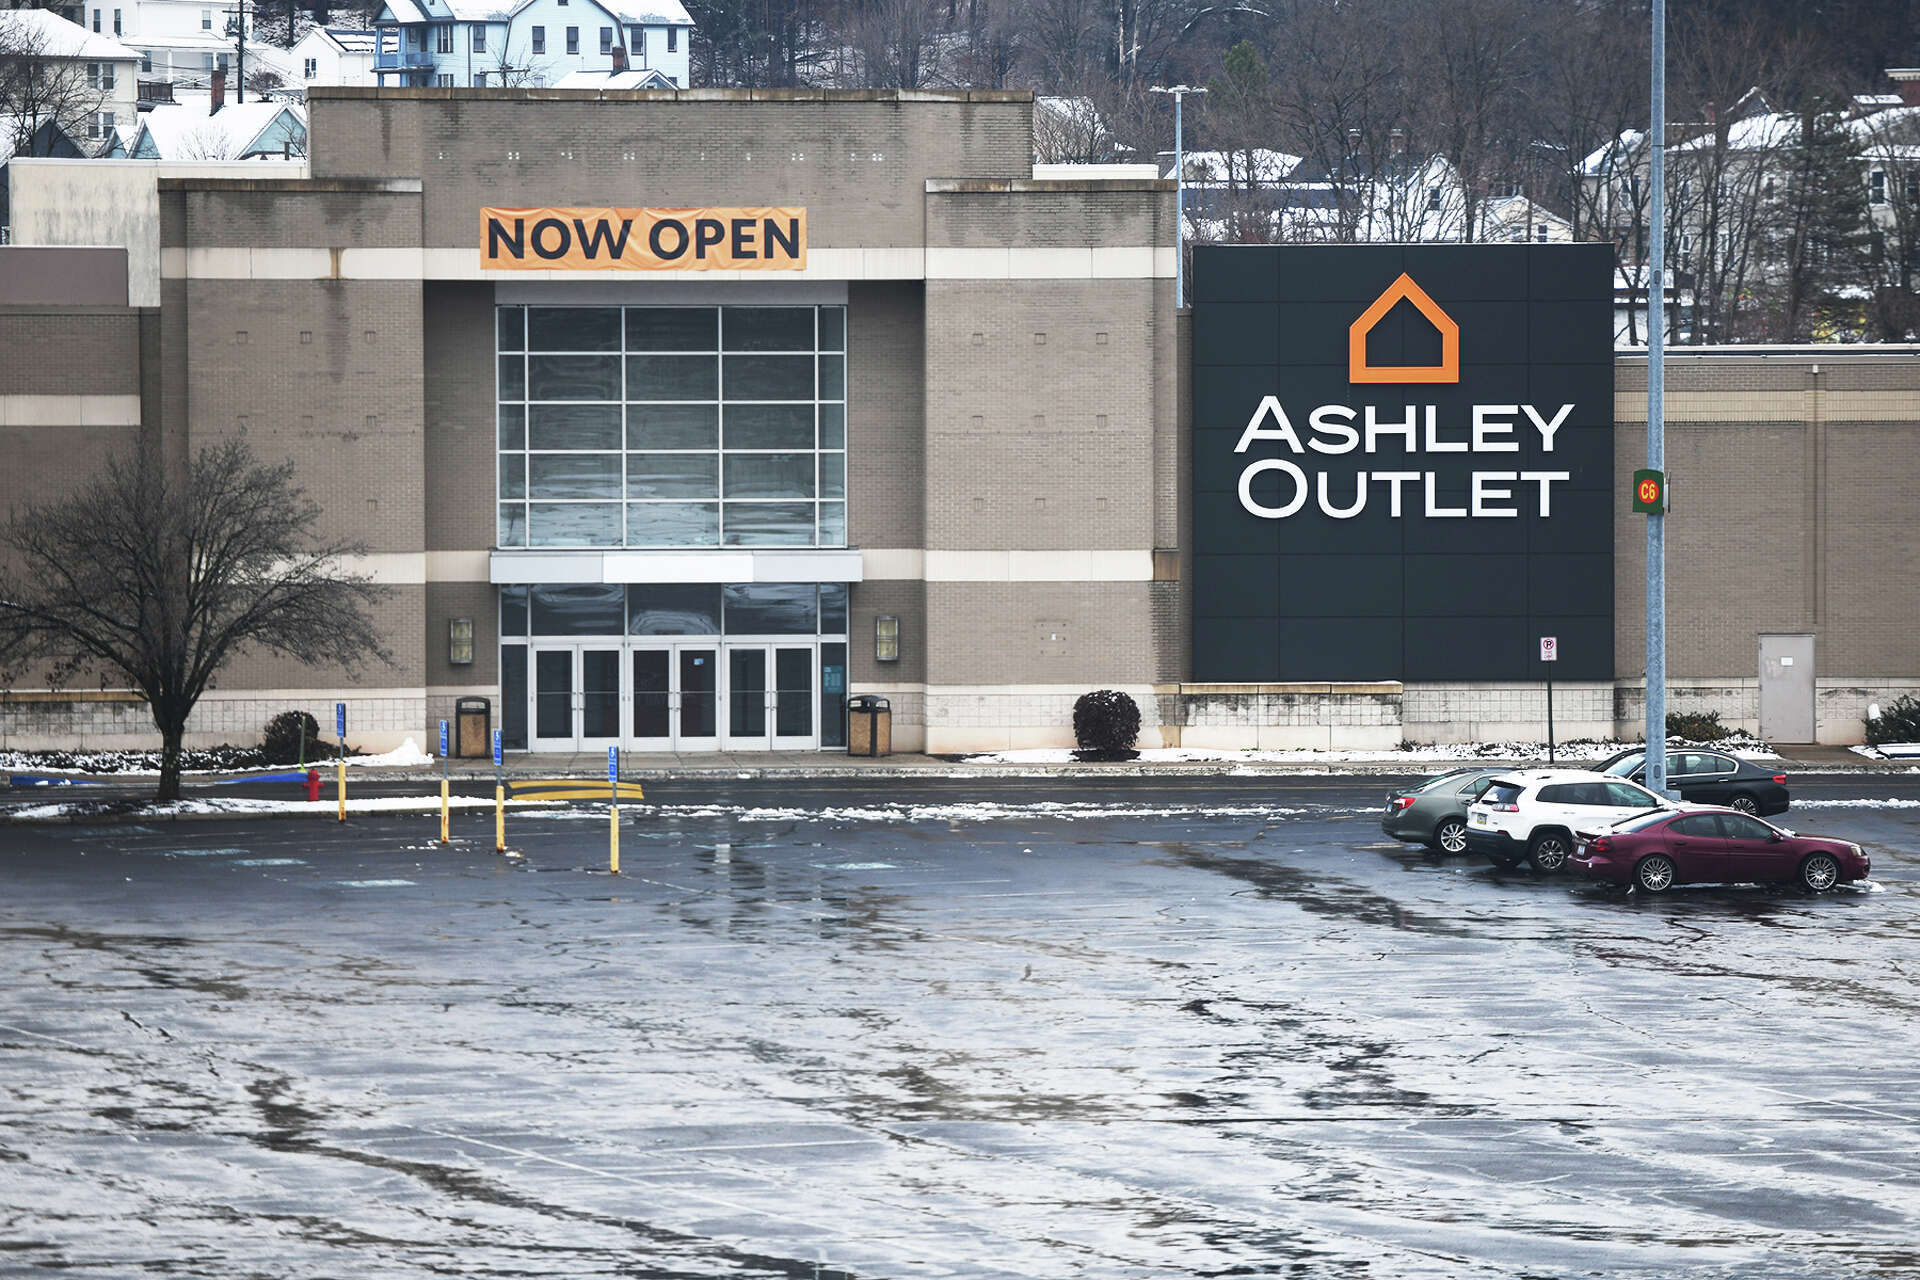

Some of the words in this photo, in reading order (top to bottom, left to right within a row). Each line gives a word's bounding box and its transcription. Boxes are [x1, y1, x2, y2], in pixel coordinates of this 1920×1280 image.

[488, 218, 633, 260] NOW
[648, 218, 800, 261] OPEN
[1233, 395, 1575, 455] ASHLEY
[1238, 458, 1570, 519] OUTLET
[1640, 482, 1656, 500] C6
